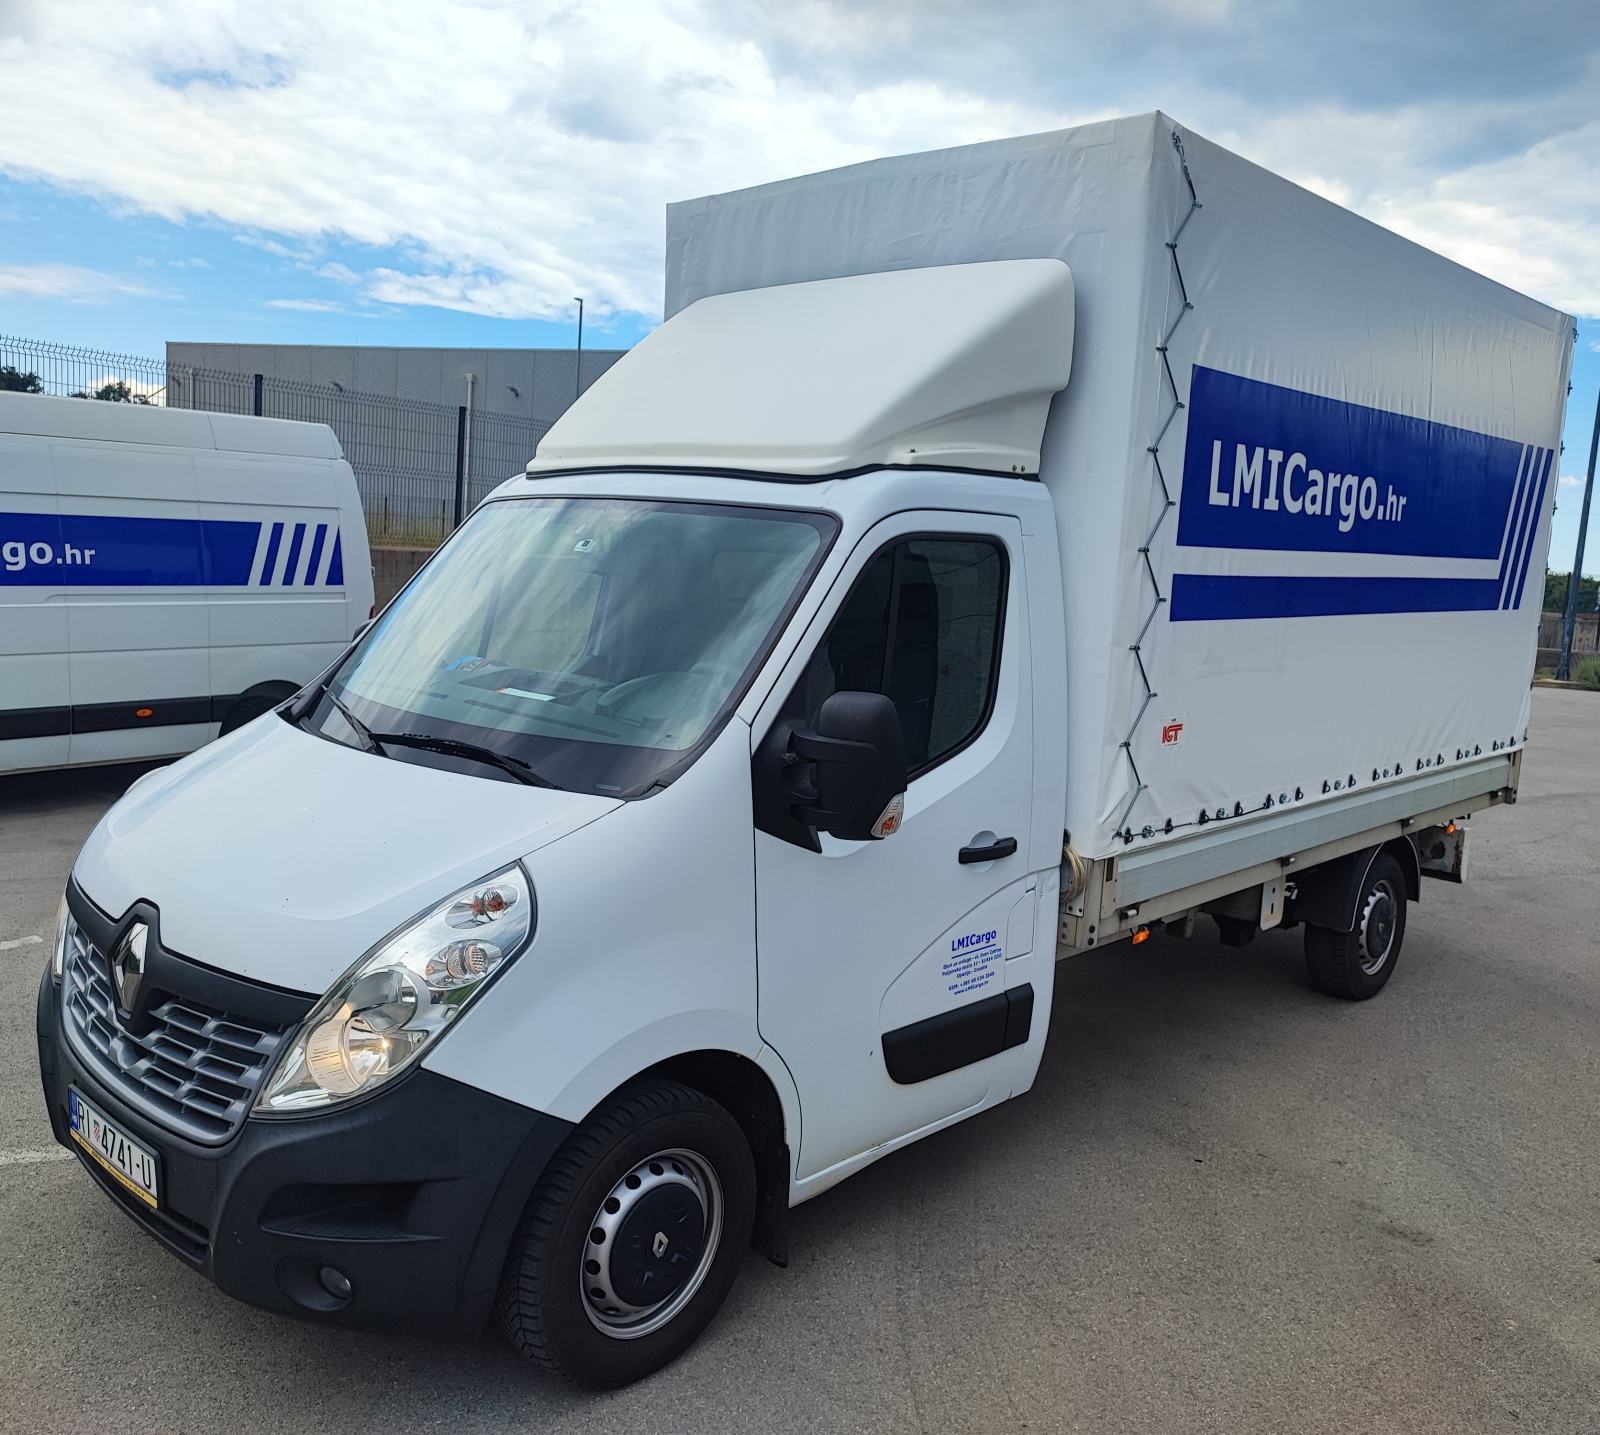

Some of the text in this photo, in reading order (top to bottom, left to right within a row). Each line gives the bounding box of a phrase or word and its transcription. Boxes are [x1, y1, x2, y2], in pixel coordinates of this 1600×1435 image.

[1208, 439, 1407, 533] LMICargo.hr
[2, 541, 96, 571] go.hr
[951, 930, 997, 951] LMICargo
[77, 1100, 91, 1139] RI
[101, 1124, 152, 1190] 4741-U
